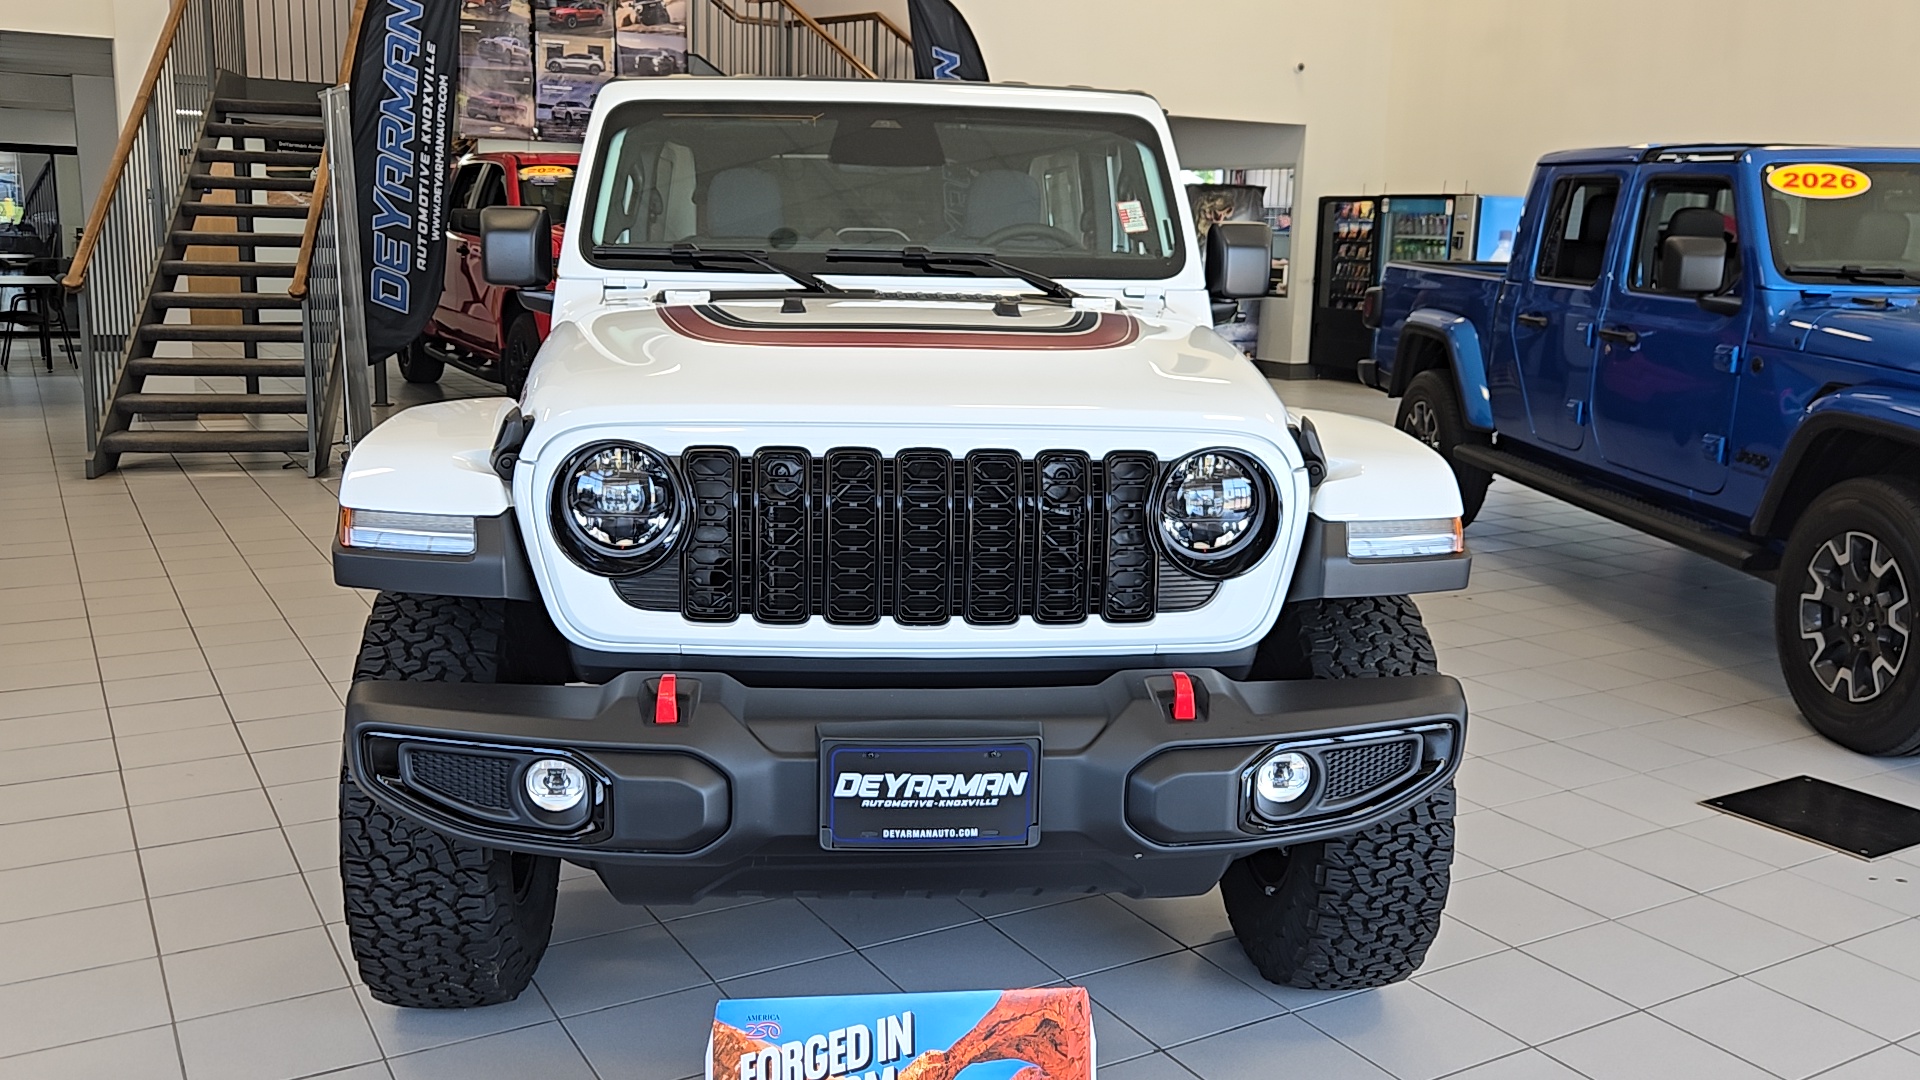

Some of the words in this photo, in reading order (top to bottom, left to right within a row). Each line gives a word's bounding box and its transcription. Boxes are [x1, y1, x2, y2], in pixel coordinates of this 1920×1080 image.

[371, 0, 424, 314] DEYARMAN
[431, 74, 449, 241] WWW.DEYARMANAUTO.COM
[1782, 172, 1858, 189] 2026
[833, 772, 1028, 798] DEYARMAN
[882, 828, 979, 839] DEYARMANAUTO.COM
[746, 1014, 781, 1022] AMERICA
[740, 1023, 872, 1080] FORGED
[877, 1010, 915, 1064] IN
